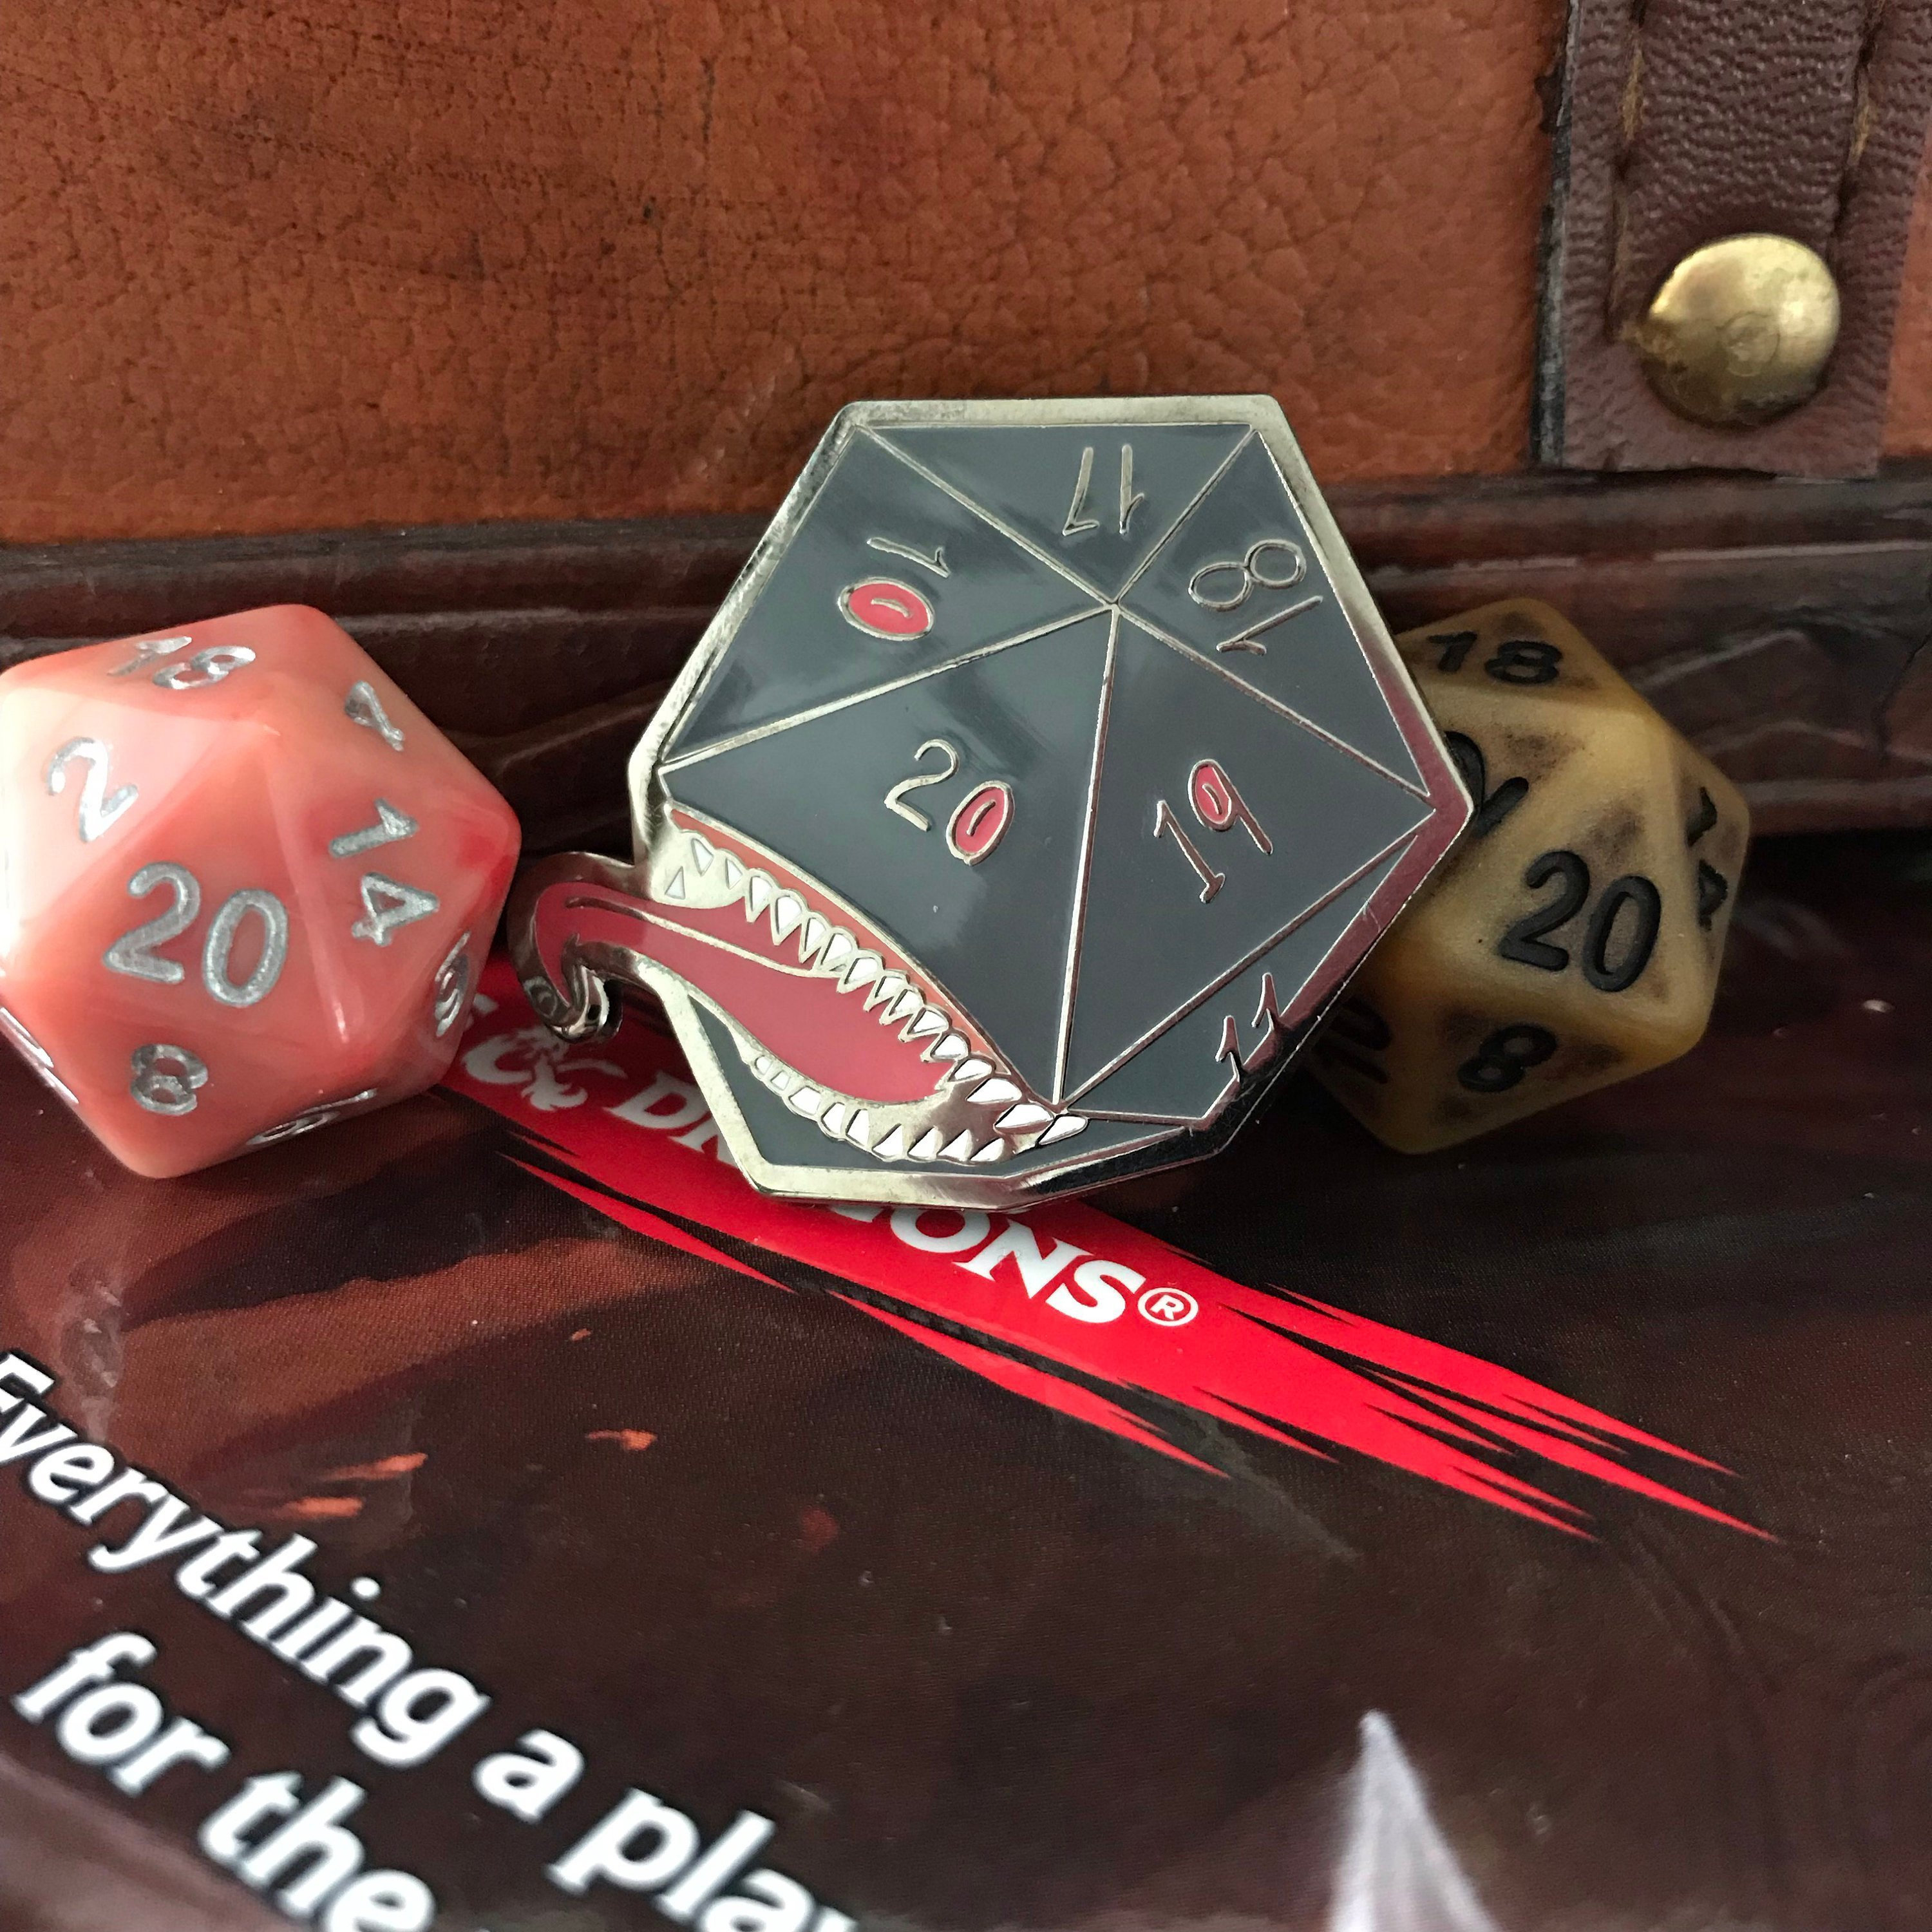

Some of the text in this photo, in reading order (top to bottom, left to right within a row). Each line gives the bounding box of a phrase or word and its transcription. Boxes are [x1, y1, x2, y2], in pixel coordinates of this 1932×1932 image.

[1062, 444, 1145, 536] 17
[838, 536, 951, 641] 10
[1188, 539, 1323, 656] 18
[1427, 630, 1563, 685] 18
[47, 737, 137, 842] 2
[885, 739, 1016, 866] 20
[1153, 758, 1274, 904] 19
[329, 799, 439, 945] 14
[1498, 850, 1662, 992] 20
[103, 862, 288, 1007] 20
[131, 1044, 208, 1115] 8
[1215, 972, 1288, 1082] 11
[1457, 1024, 1557, 1092] 8
[13, 1633, 435, 1932] for the
[473, 1728, 586, 1821] a
[545, 1787, 858, 1932] pla
